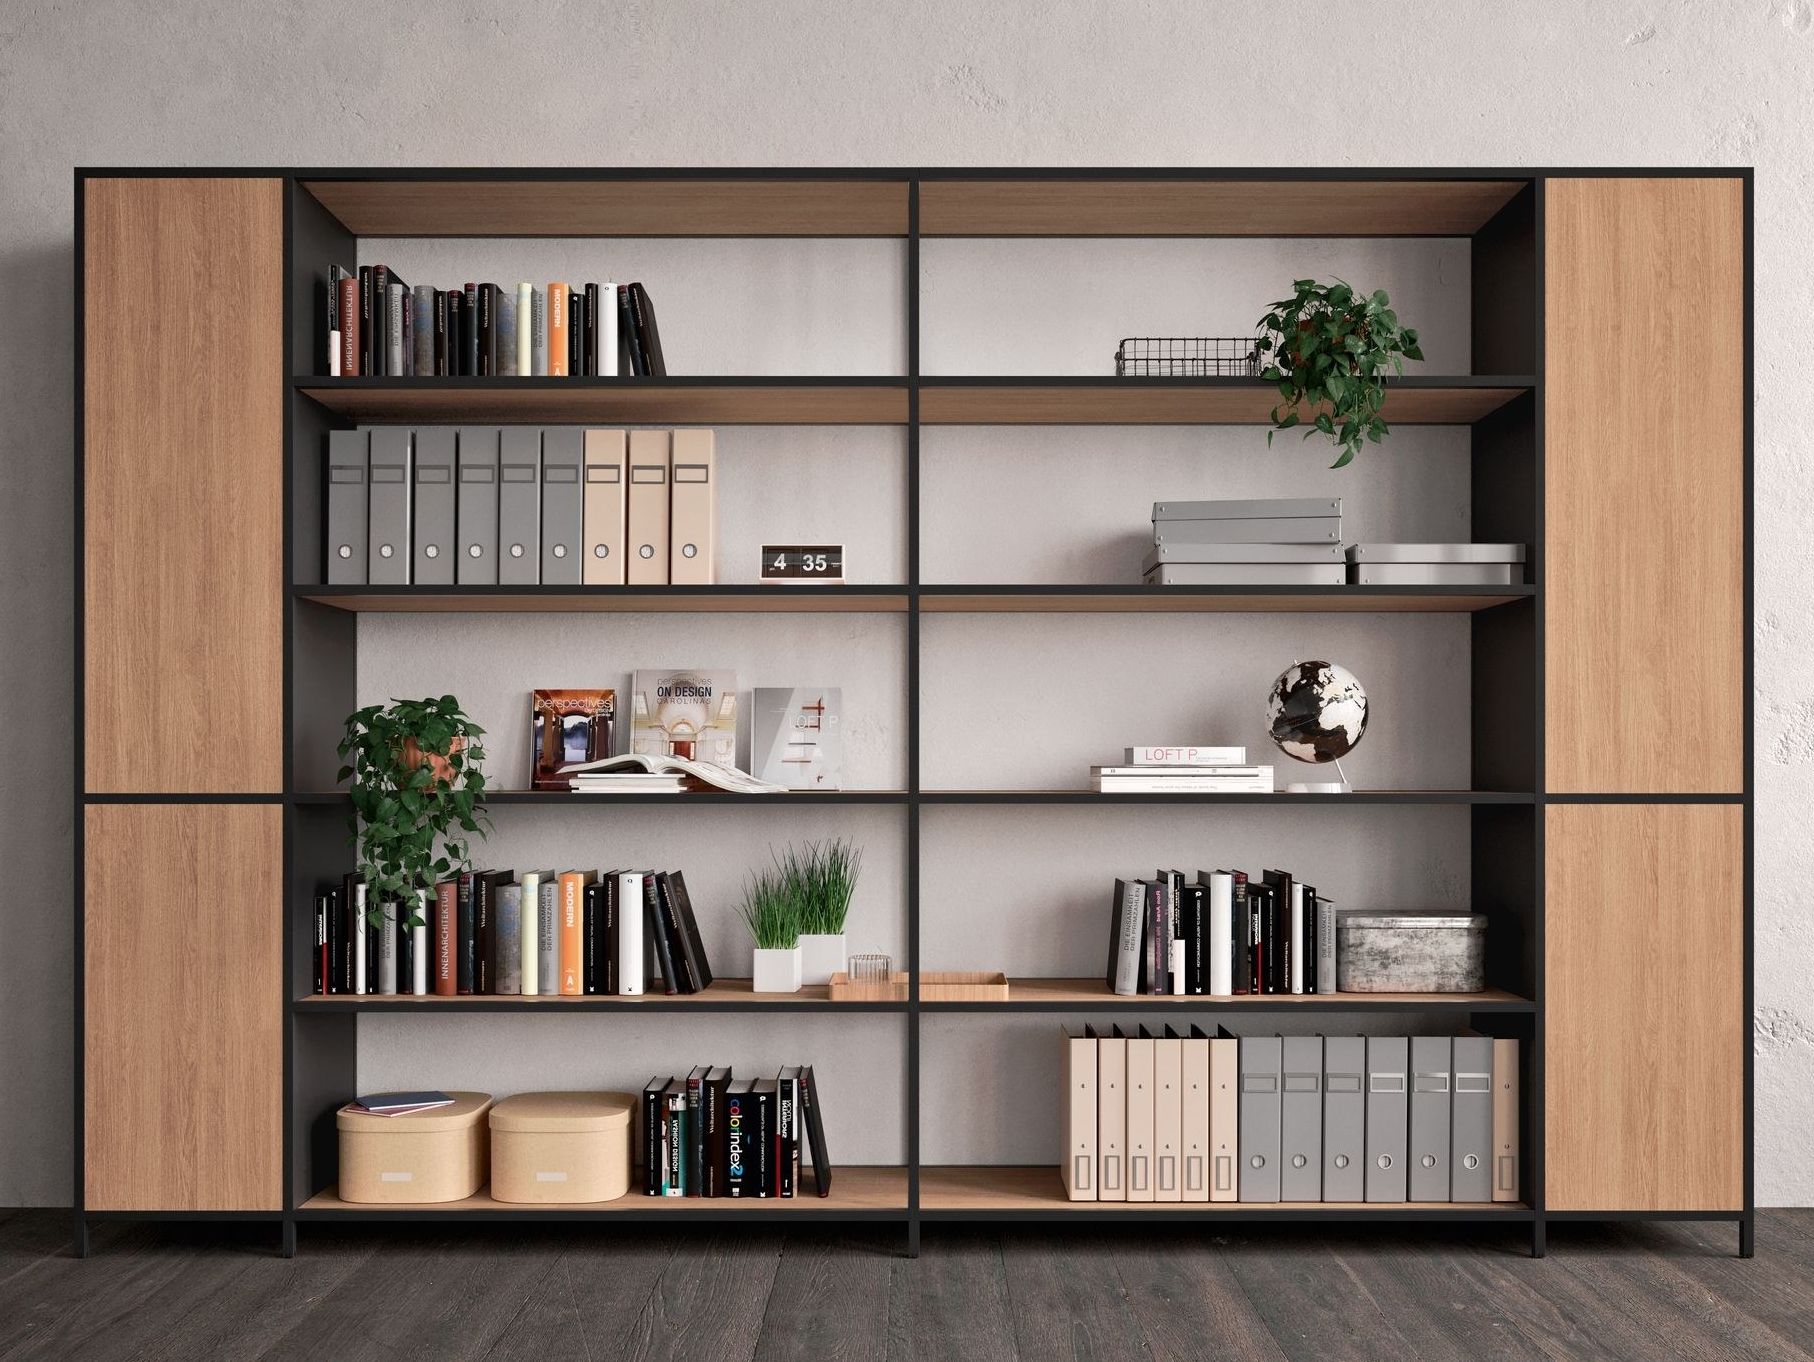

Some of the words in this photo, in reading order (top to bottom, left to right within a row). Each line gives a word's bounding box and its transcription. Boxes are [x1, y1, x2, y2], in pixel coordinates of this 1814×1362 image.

[774, 553, 786, 570] 4
[802, 554, 827, 571] 35
[657, 686, 672, 697] ON
[675, 686, 712, 697] DESIGN
[538, 696, 612, 710] perspectives
[656, 697, 712, 705] CAROLINAS
[1145, 748, 1184, 761] LOFT
[1188, 748, 1198, 760] P
[566, 881, 574, 927] MODERN
[441, 890, 449, 979] INNENARCHITEKTUR
